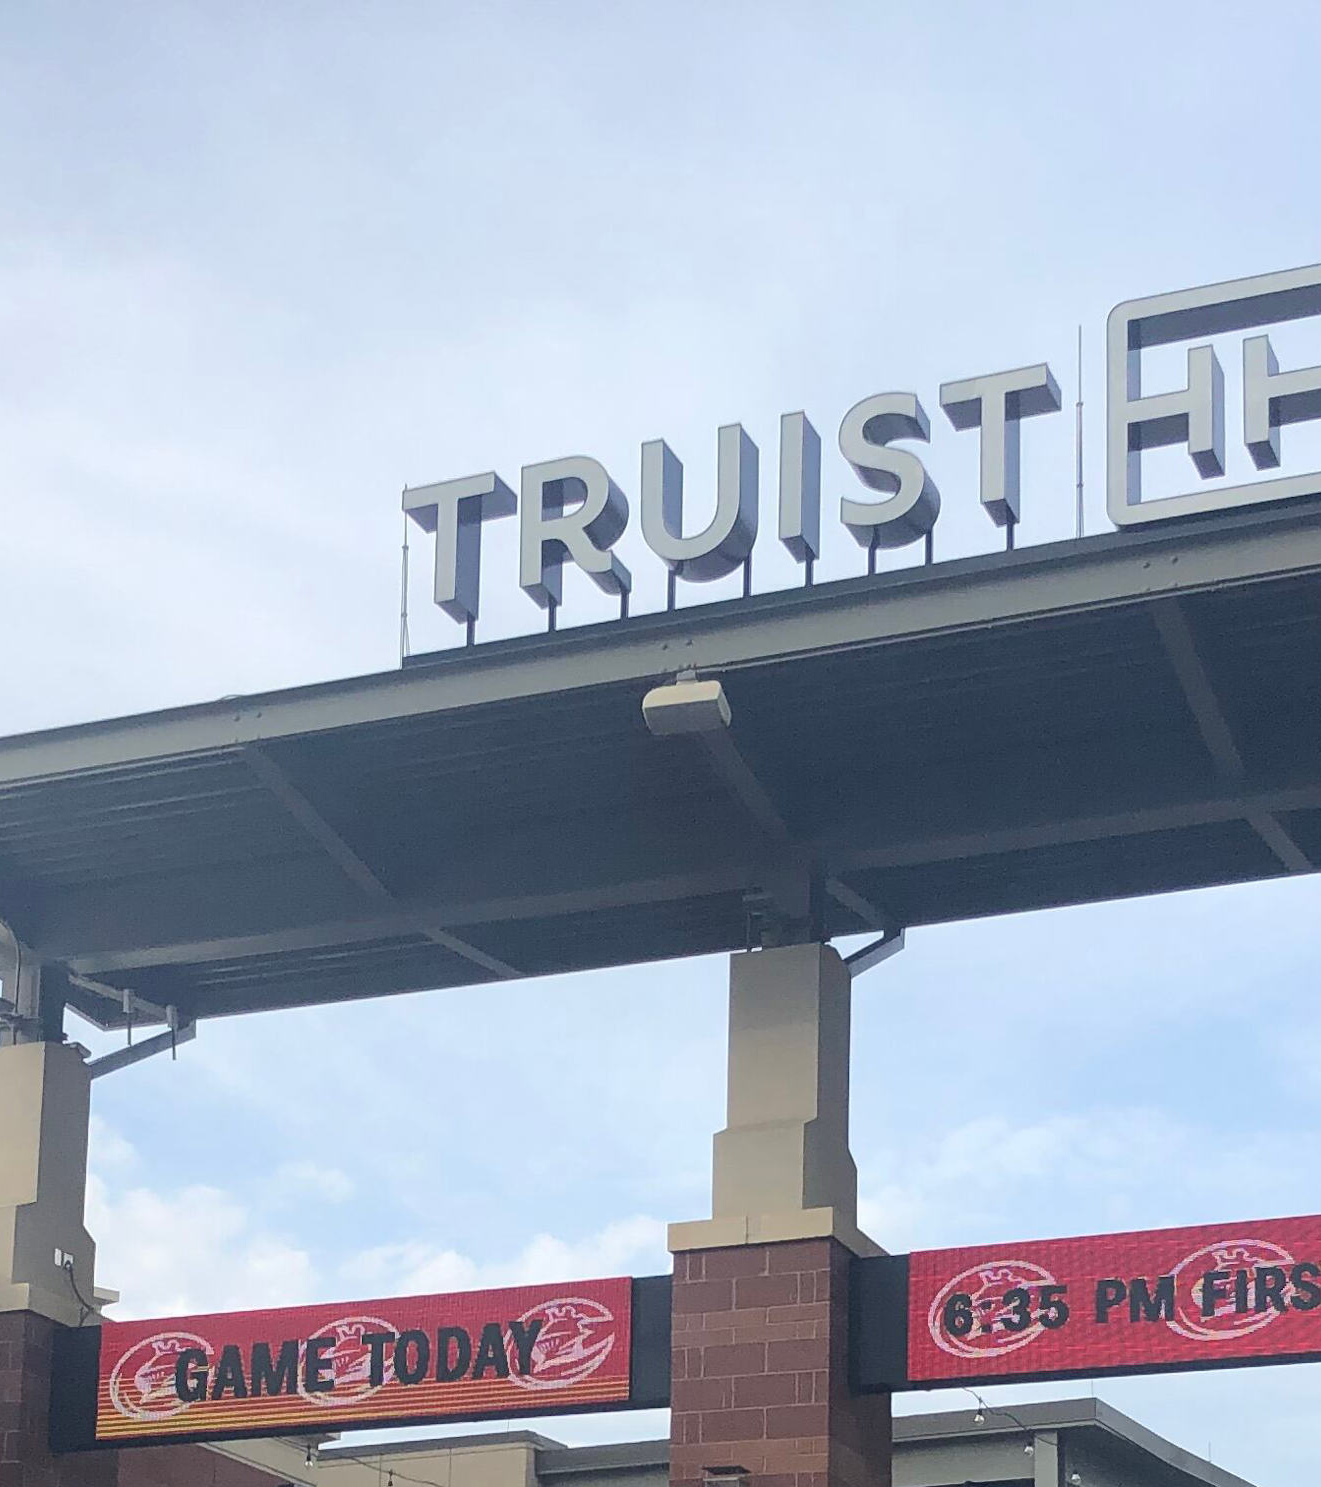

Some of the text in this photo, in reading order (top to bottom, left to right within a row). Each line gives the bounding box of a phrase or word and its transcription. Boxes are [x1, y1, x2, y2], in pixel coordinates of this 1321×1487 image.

[403, 362, 1064, 624] TRUIST
[943, 1284, 1070, 1337] 6:35
[1095, 1273, 1175, 1323] PM
[174, 1318, 545, 1402] GAME TODAY
